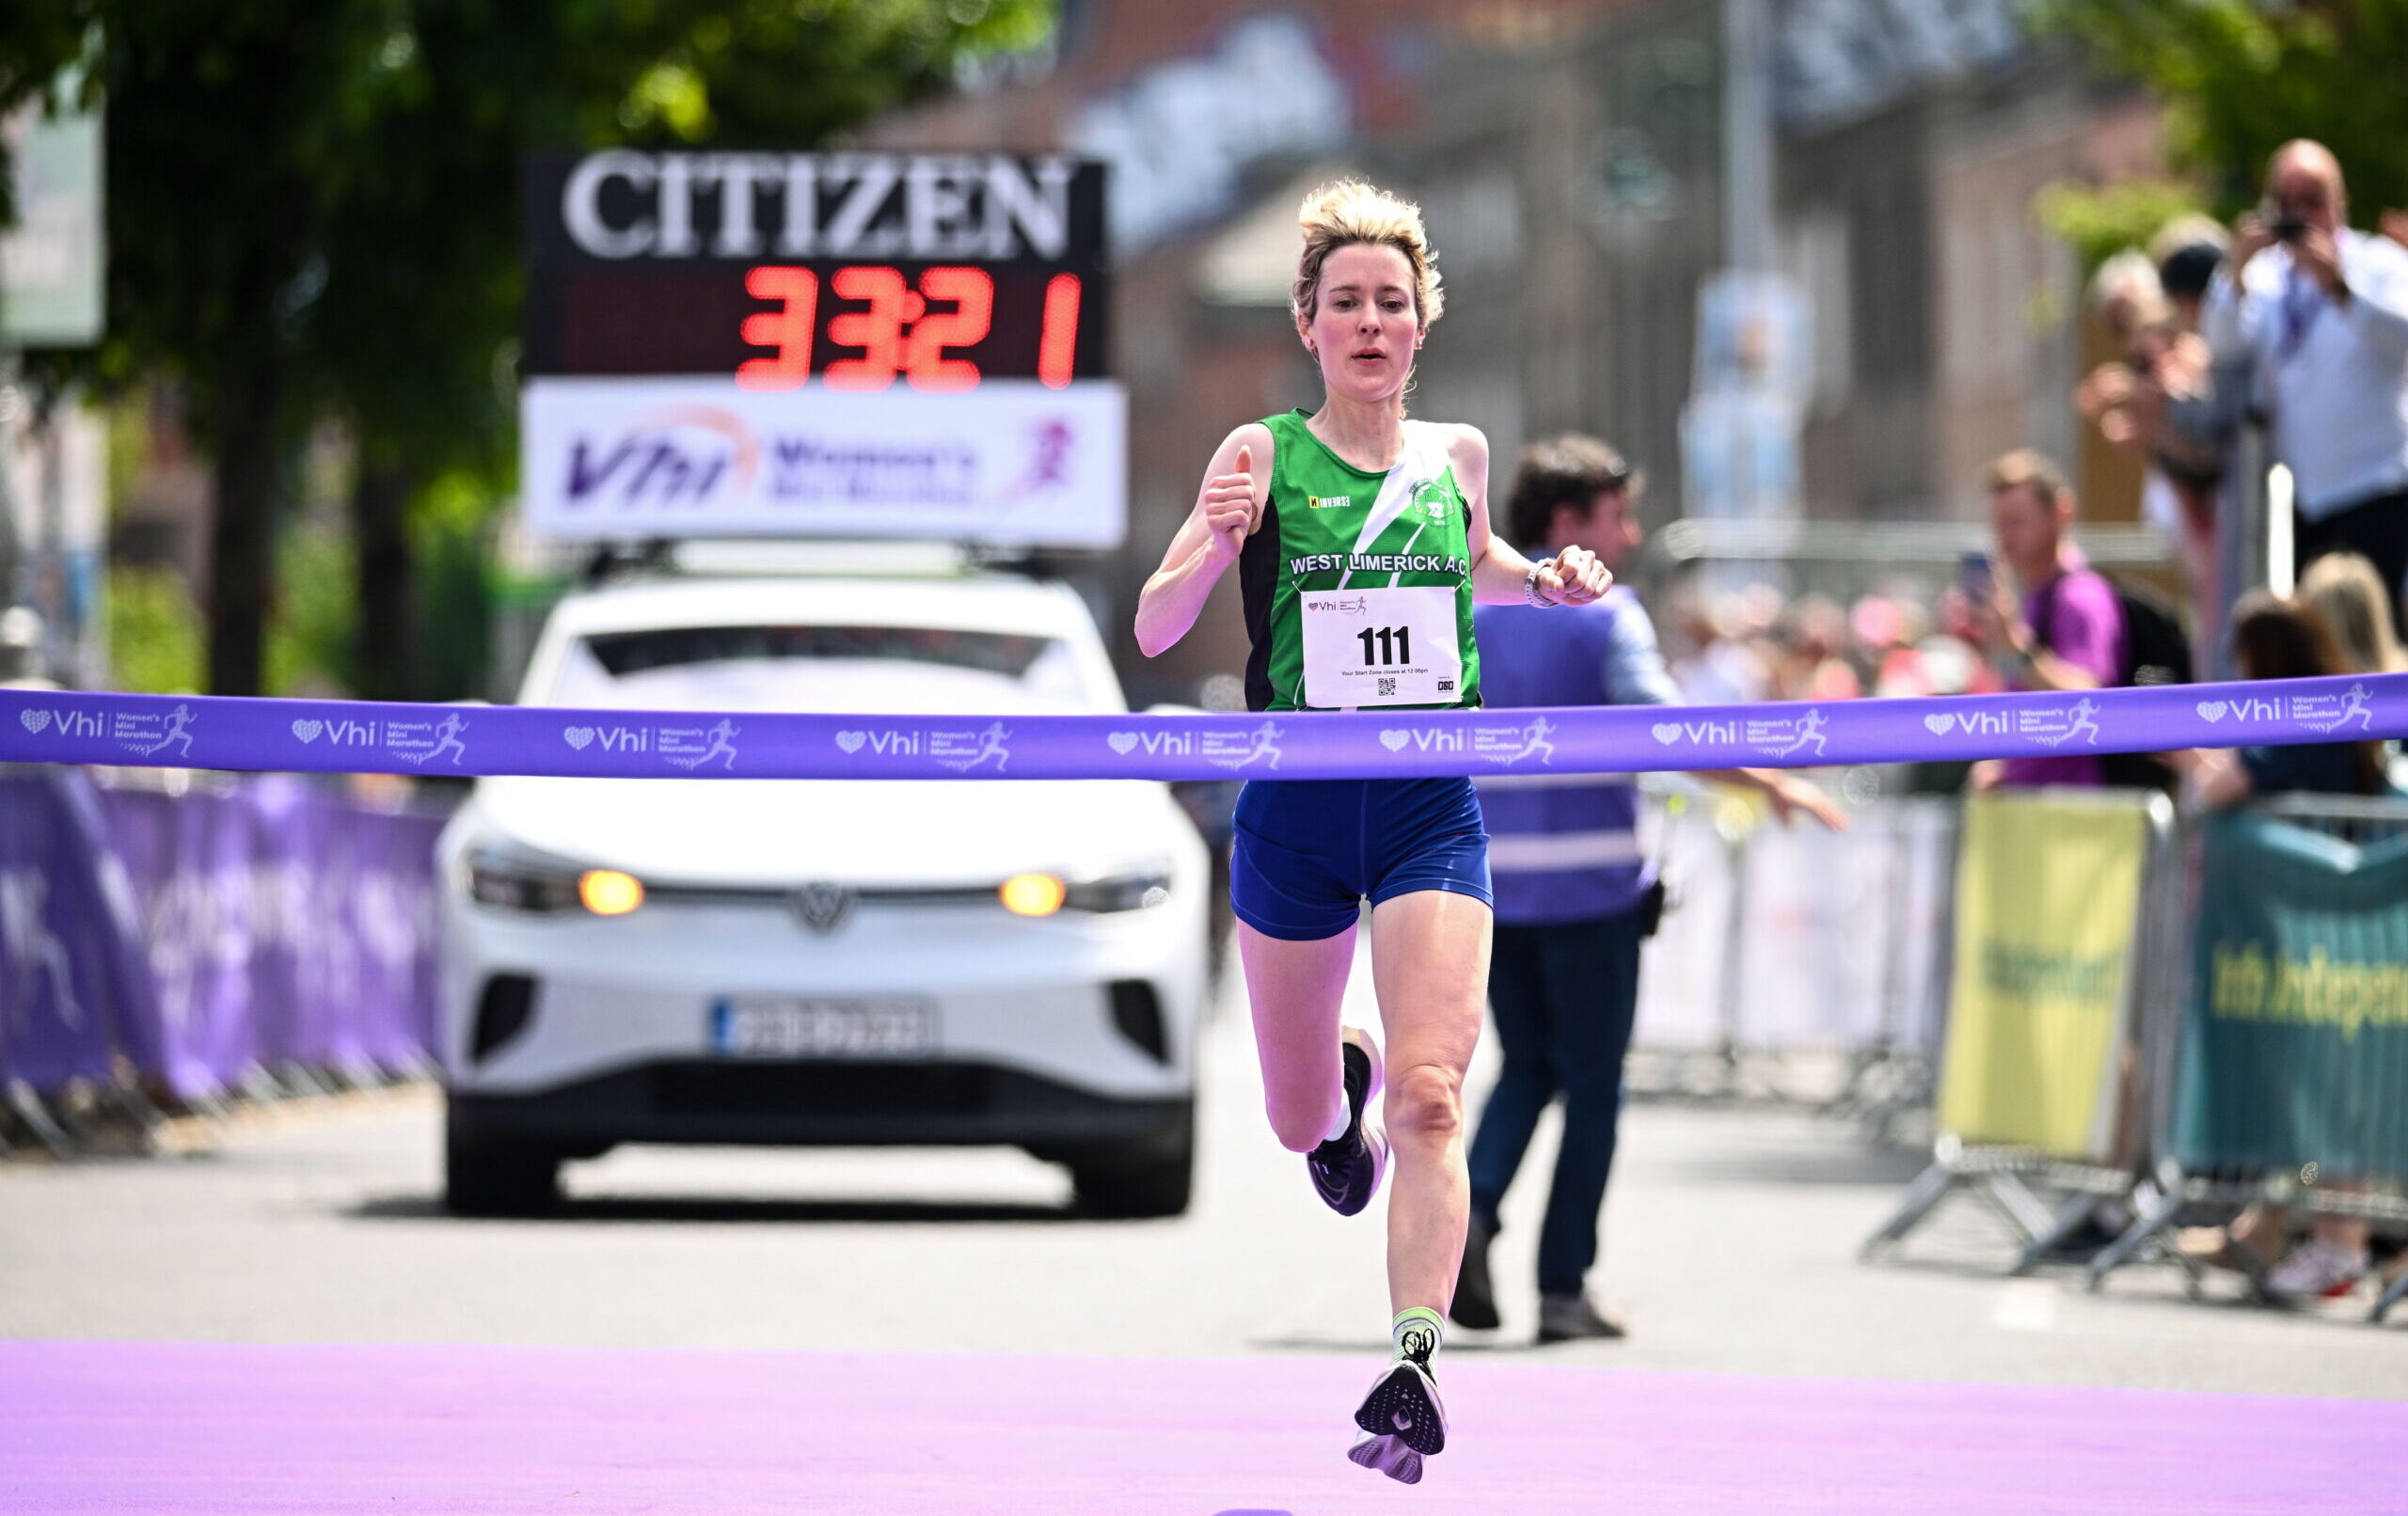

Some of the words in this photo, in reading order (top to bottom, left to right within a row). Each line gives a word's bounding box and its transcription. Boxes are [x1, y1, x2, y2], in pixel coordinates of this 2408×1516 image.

[562, 149, 1076, 260] CITIZEN
[1290, 554, 1343, 575] WEST
[1349, 554, 1440, 572] LIMERICK
[1319, 601, 1337, 611] Vhi
[1357, 625, 1410, 666] 111
[2228, 697, 2280, 722] Vhi
[2291, 695, 2337, 704] Women's
[53, 709, 103, 737] Vhi
[116, 712, 160, 722] Women's
[1956, 710, 2008, 734] Vhi
[2019, 708, 2064, 717] Women's
[2291, 710, 2341, 719] Marathon
[115, 730, 162, 739] Marathon
[325, 719, 376, 746] Vhi
[388, 721, 433, 731] Women's
[1684, 721, 1735, 744] Vhi
[387, 738, 434, 748] Marathon
[596, 727, 648, 751] Vhi
[867, 731, 919, 755] Vhi
[1139, 731, 1192, 755] Vhi
[1412, 728, 1463, 751] Vhi
[1747, 734, 1795, 743] Marathon
